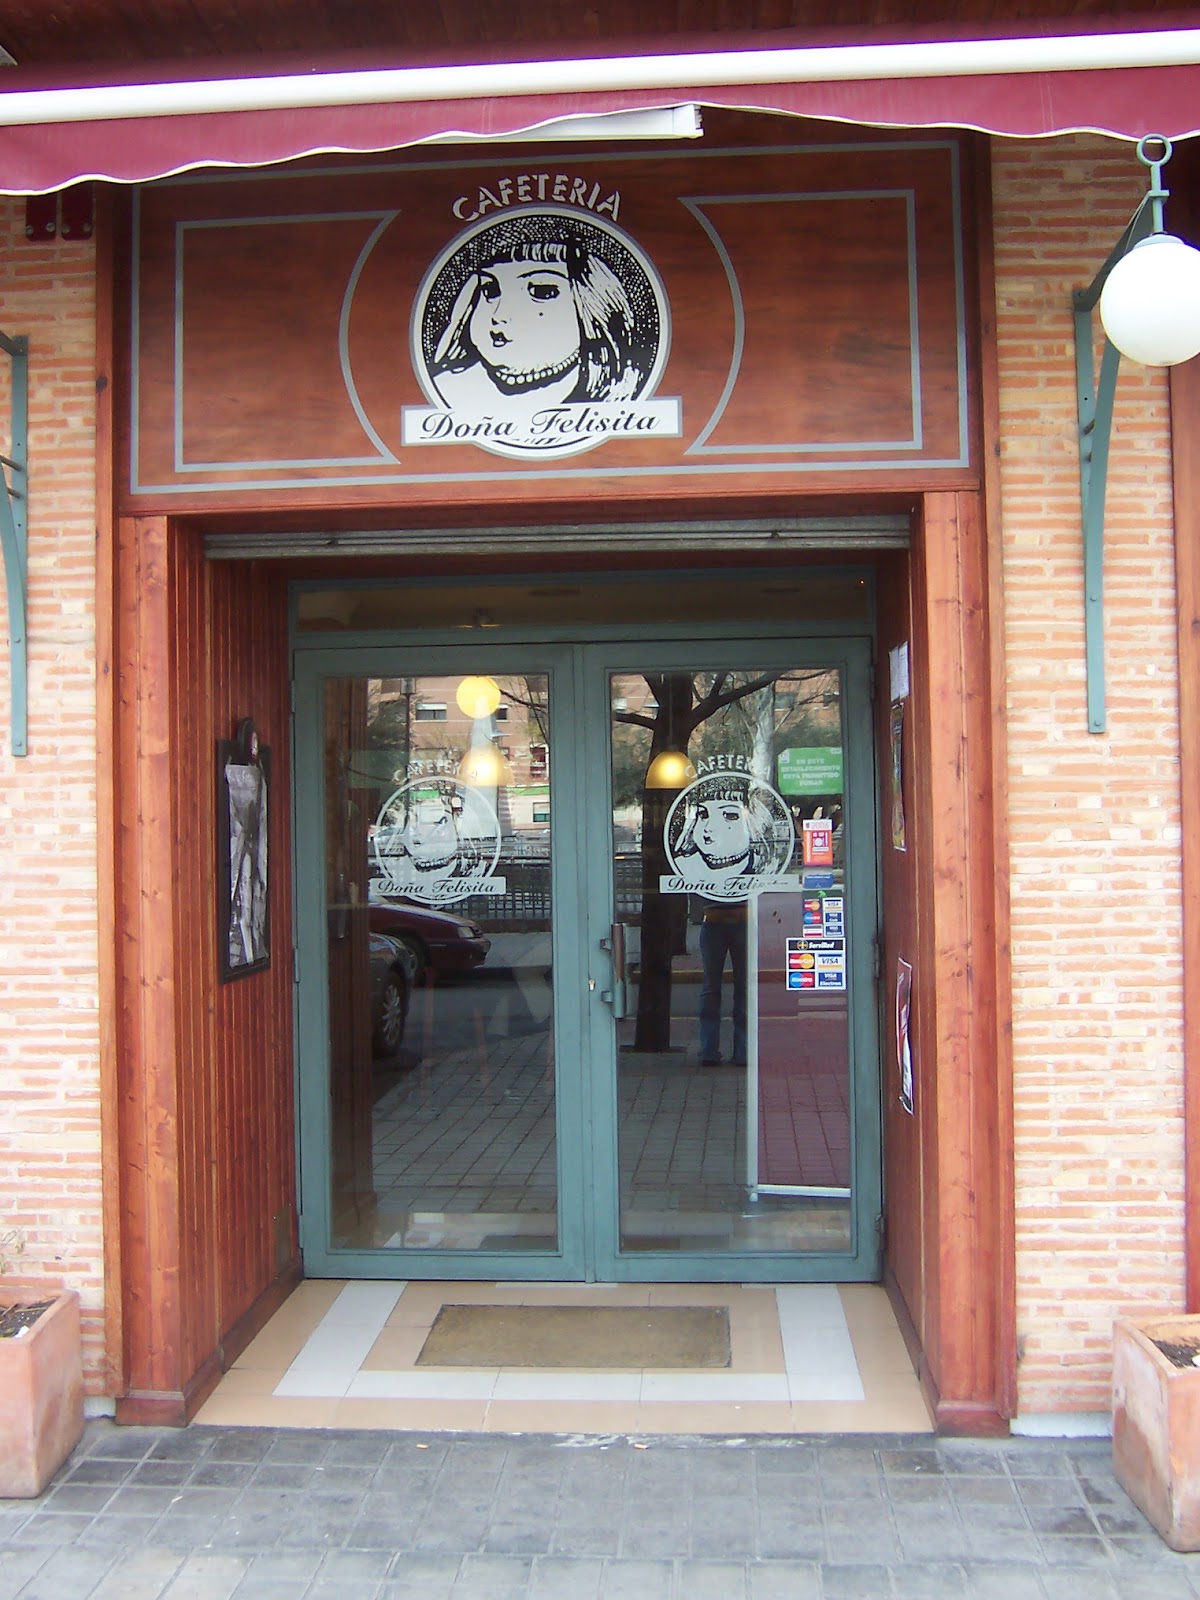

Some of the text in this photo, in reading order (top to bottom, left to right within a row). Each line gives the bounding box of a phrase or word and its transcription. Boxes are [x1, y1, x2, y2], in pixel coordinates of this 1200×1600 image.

[452, 173, 620, 222] CAFETERIA
[420, 407, 660, 440] Doña Felisita
[393, 759, 478, 785] CAFETE
[684, 754, 771, 779] CAFETER
[377, 879, 496, 894] Doña Felisita
[667, 876, 788, 891] Doña Feli
